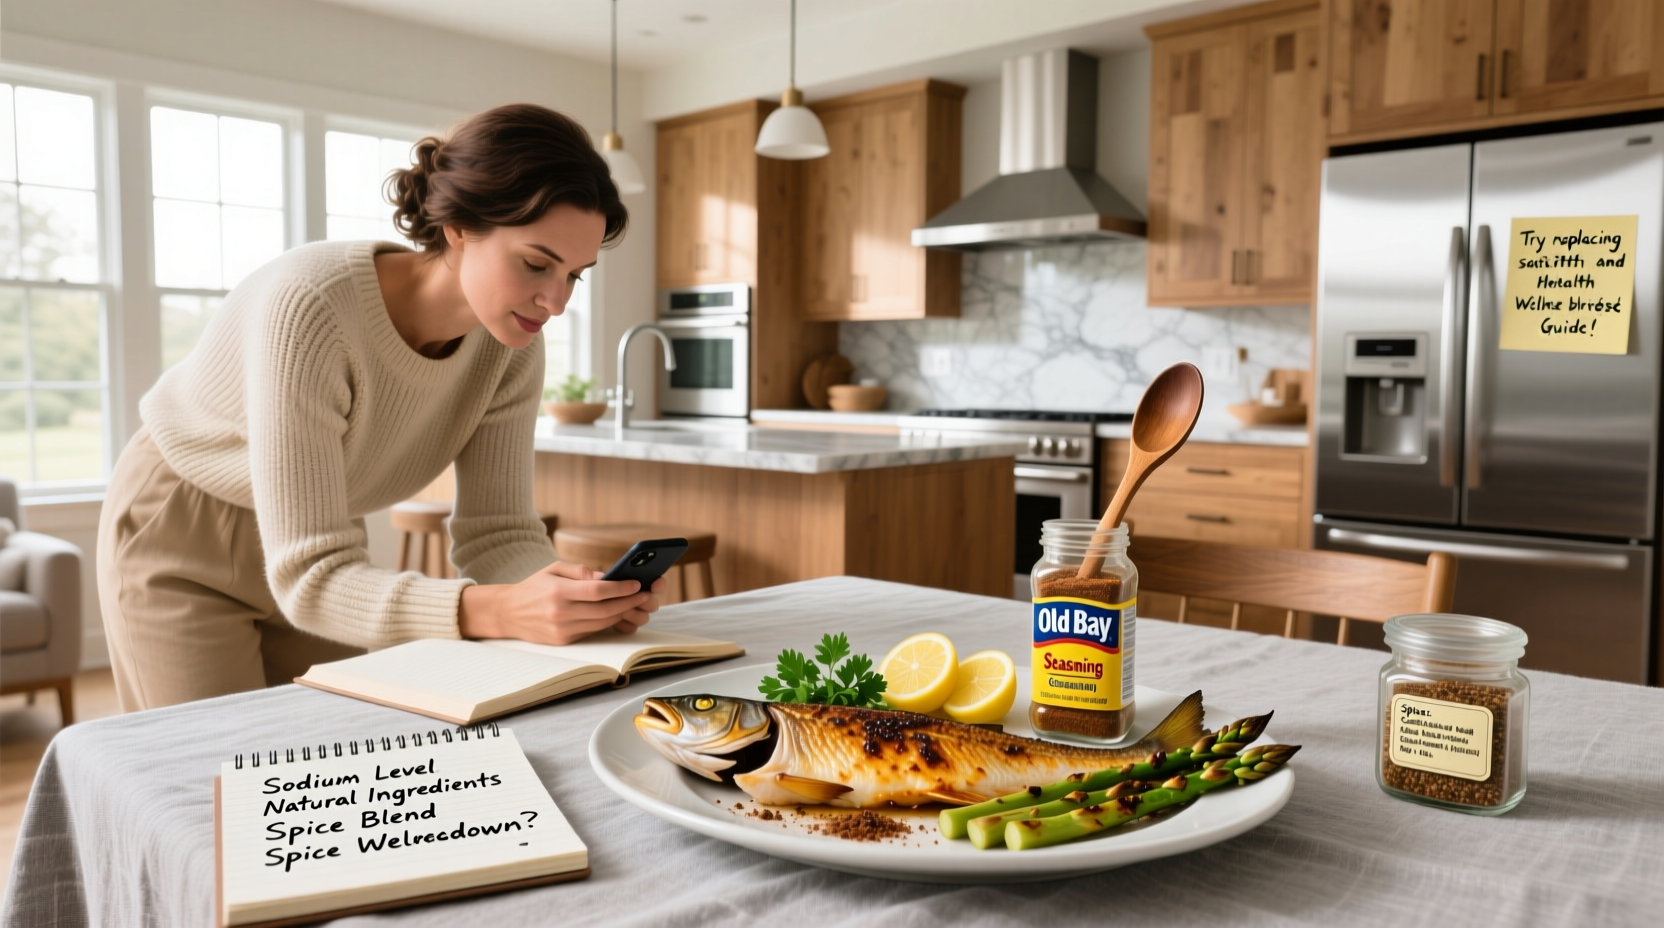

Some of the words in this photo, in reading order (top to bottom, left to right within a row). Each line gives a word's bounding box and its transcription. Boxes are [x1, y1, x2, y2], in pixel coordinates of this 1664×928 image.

[1520, 230, 1546, 253] Try
[1596, 253, 1626, 268] and
[1038, 608, 1070, 633] Old
[1073, 609, 1112, 643] Bay
[262, 773, 360, 795] Sodium
[375, 758, 435, 780] Level
[263, 790, 357, 816] Natural
[368, 772, 502, 806] Ingredients
[265, 820, 345, 845] Spice
[361, 803, 436, 828] Blend
[265, 846, 341, 872] Spice
